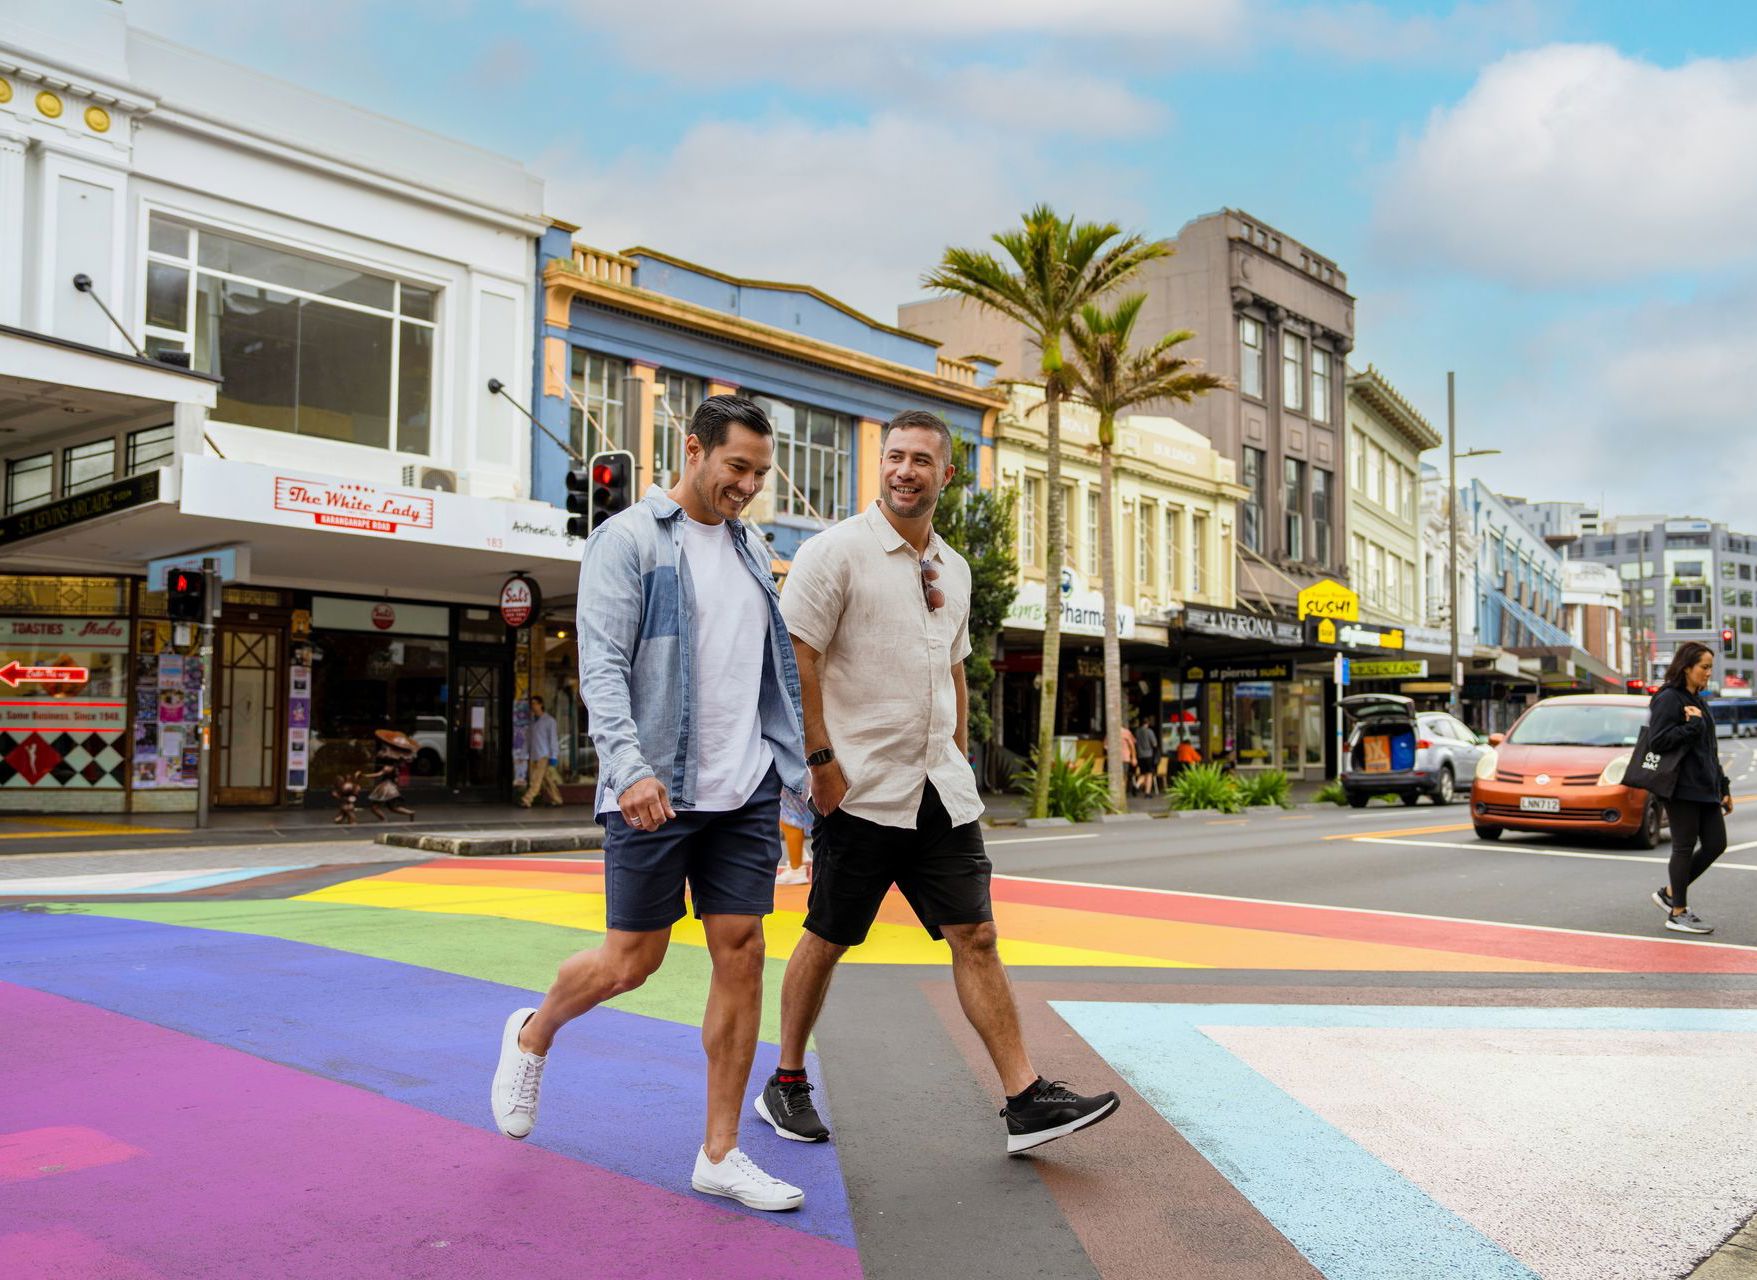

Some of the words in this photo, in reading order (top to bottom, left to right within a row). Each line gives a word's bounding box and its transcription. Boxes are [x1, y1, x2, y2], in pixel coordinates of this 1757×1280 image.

[289, 486, 322, 505] The
[325, 490, 374, 513] White
[376, 499, 421, 522] Lady
[372, 520, 391, 531] ROAD
[512, 521, 558, 537] Authentic
[486, 537, 503, 548] 183
[1306, 600, 1351, 614] SUSHI
[12, 623, 64, 635] TOASTIES
[78, 620, 123, 637] Shakes
[1219, 611, 1275, 639] VERONA
[1220, 666, 1257, 681] pierres
[1260, 664, 1287, 677] sushi
[6, 711, 30, 720] Same
[74, 711, 97, 721] Since
[1522, 798, 1559, 811] LNN712
